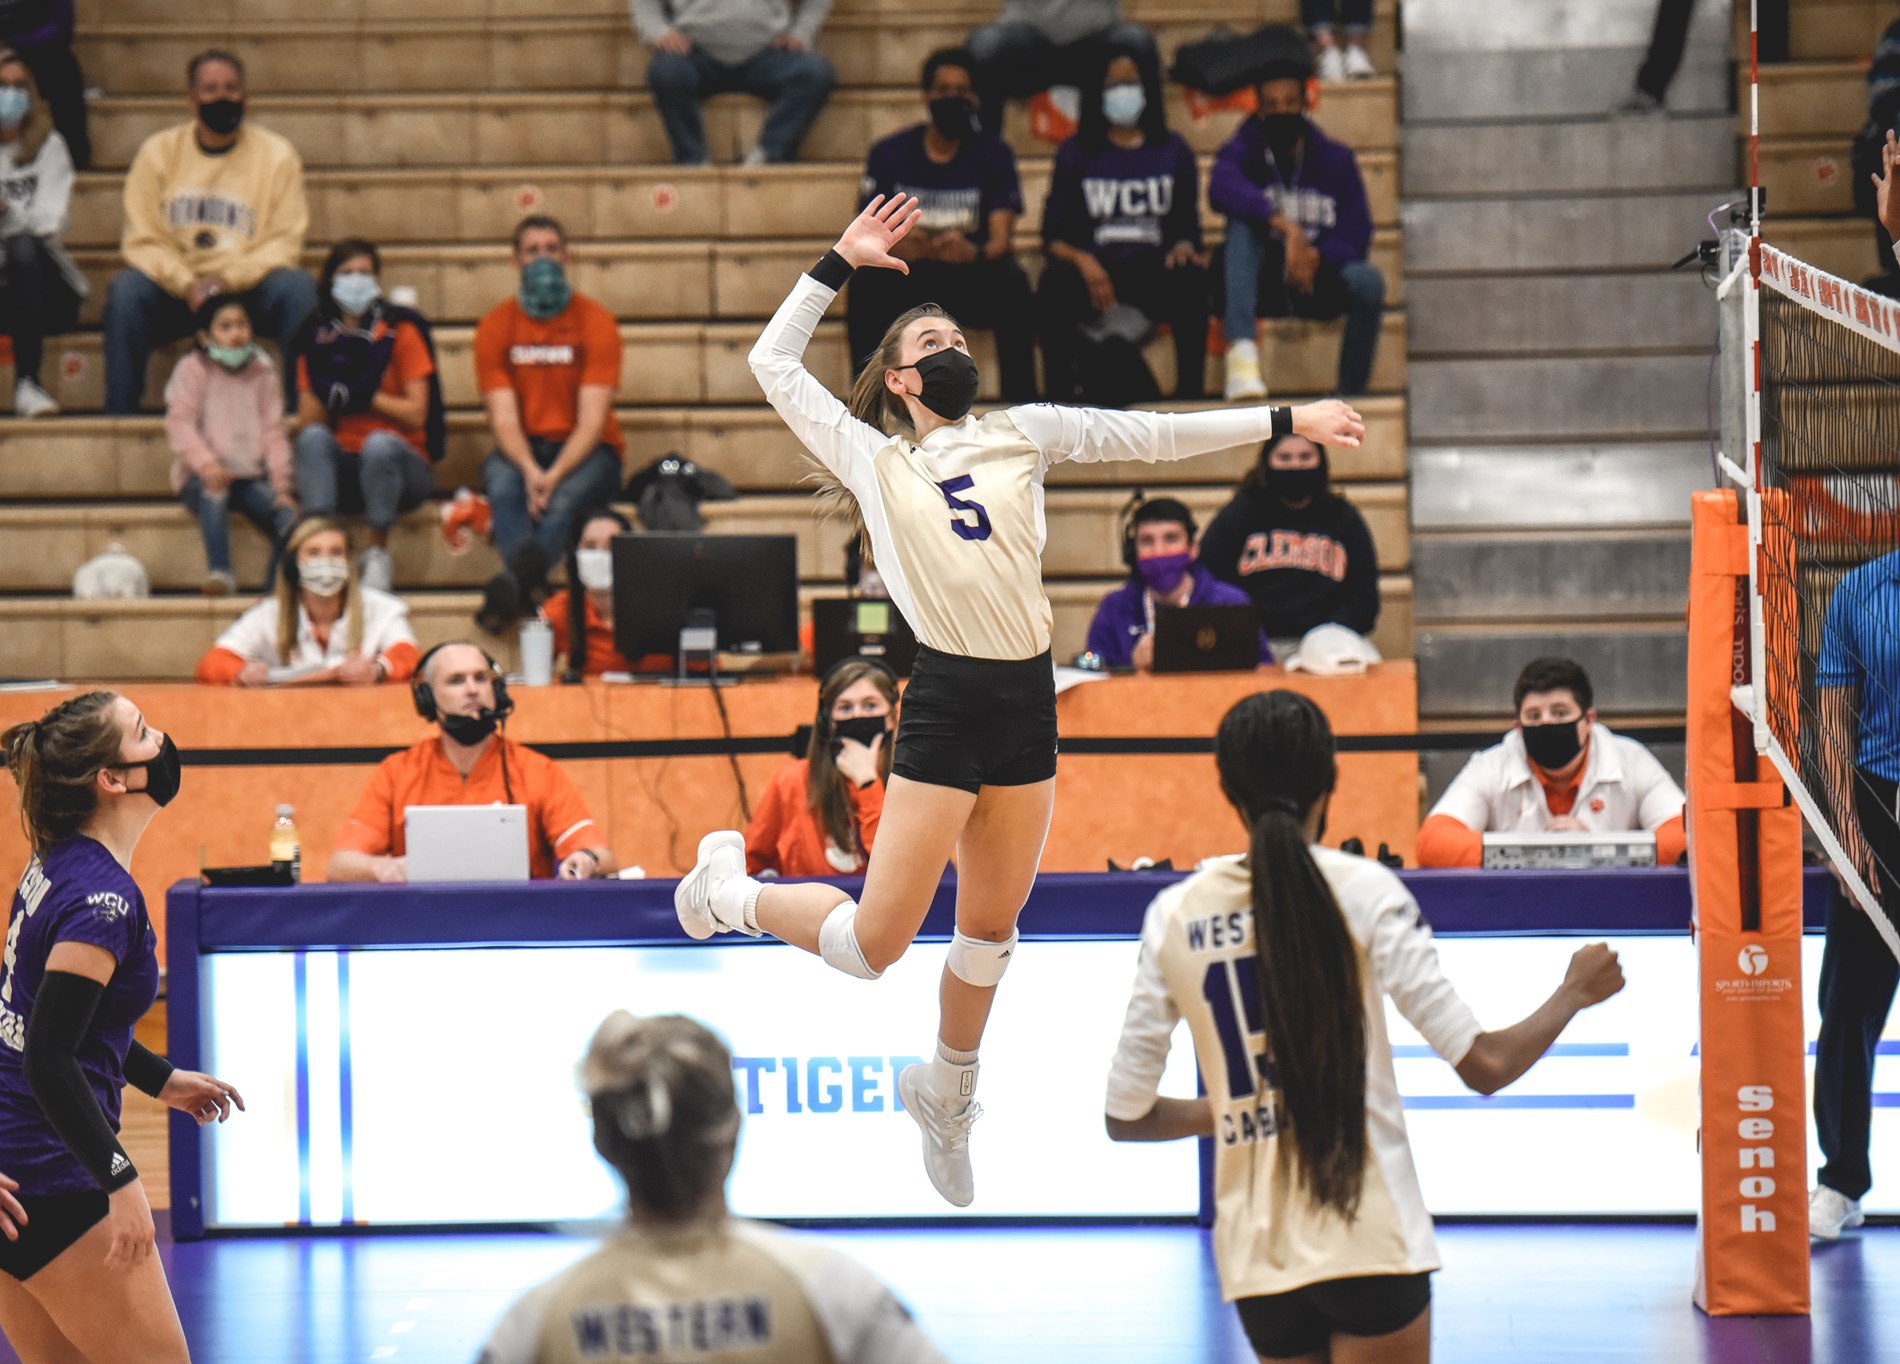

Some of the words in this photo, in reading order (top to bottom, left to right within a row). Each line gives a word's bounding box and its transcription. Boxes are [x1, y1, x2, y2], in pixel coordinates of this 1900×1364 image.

[1082, 176, 1174, 218] WCU
[934, 474, 992, 541] 5
[87, 891, 129, 916] WCU
[1187, 910, 1255, 949] WES
[1738, 1085, 1776, 1232] senoh
